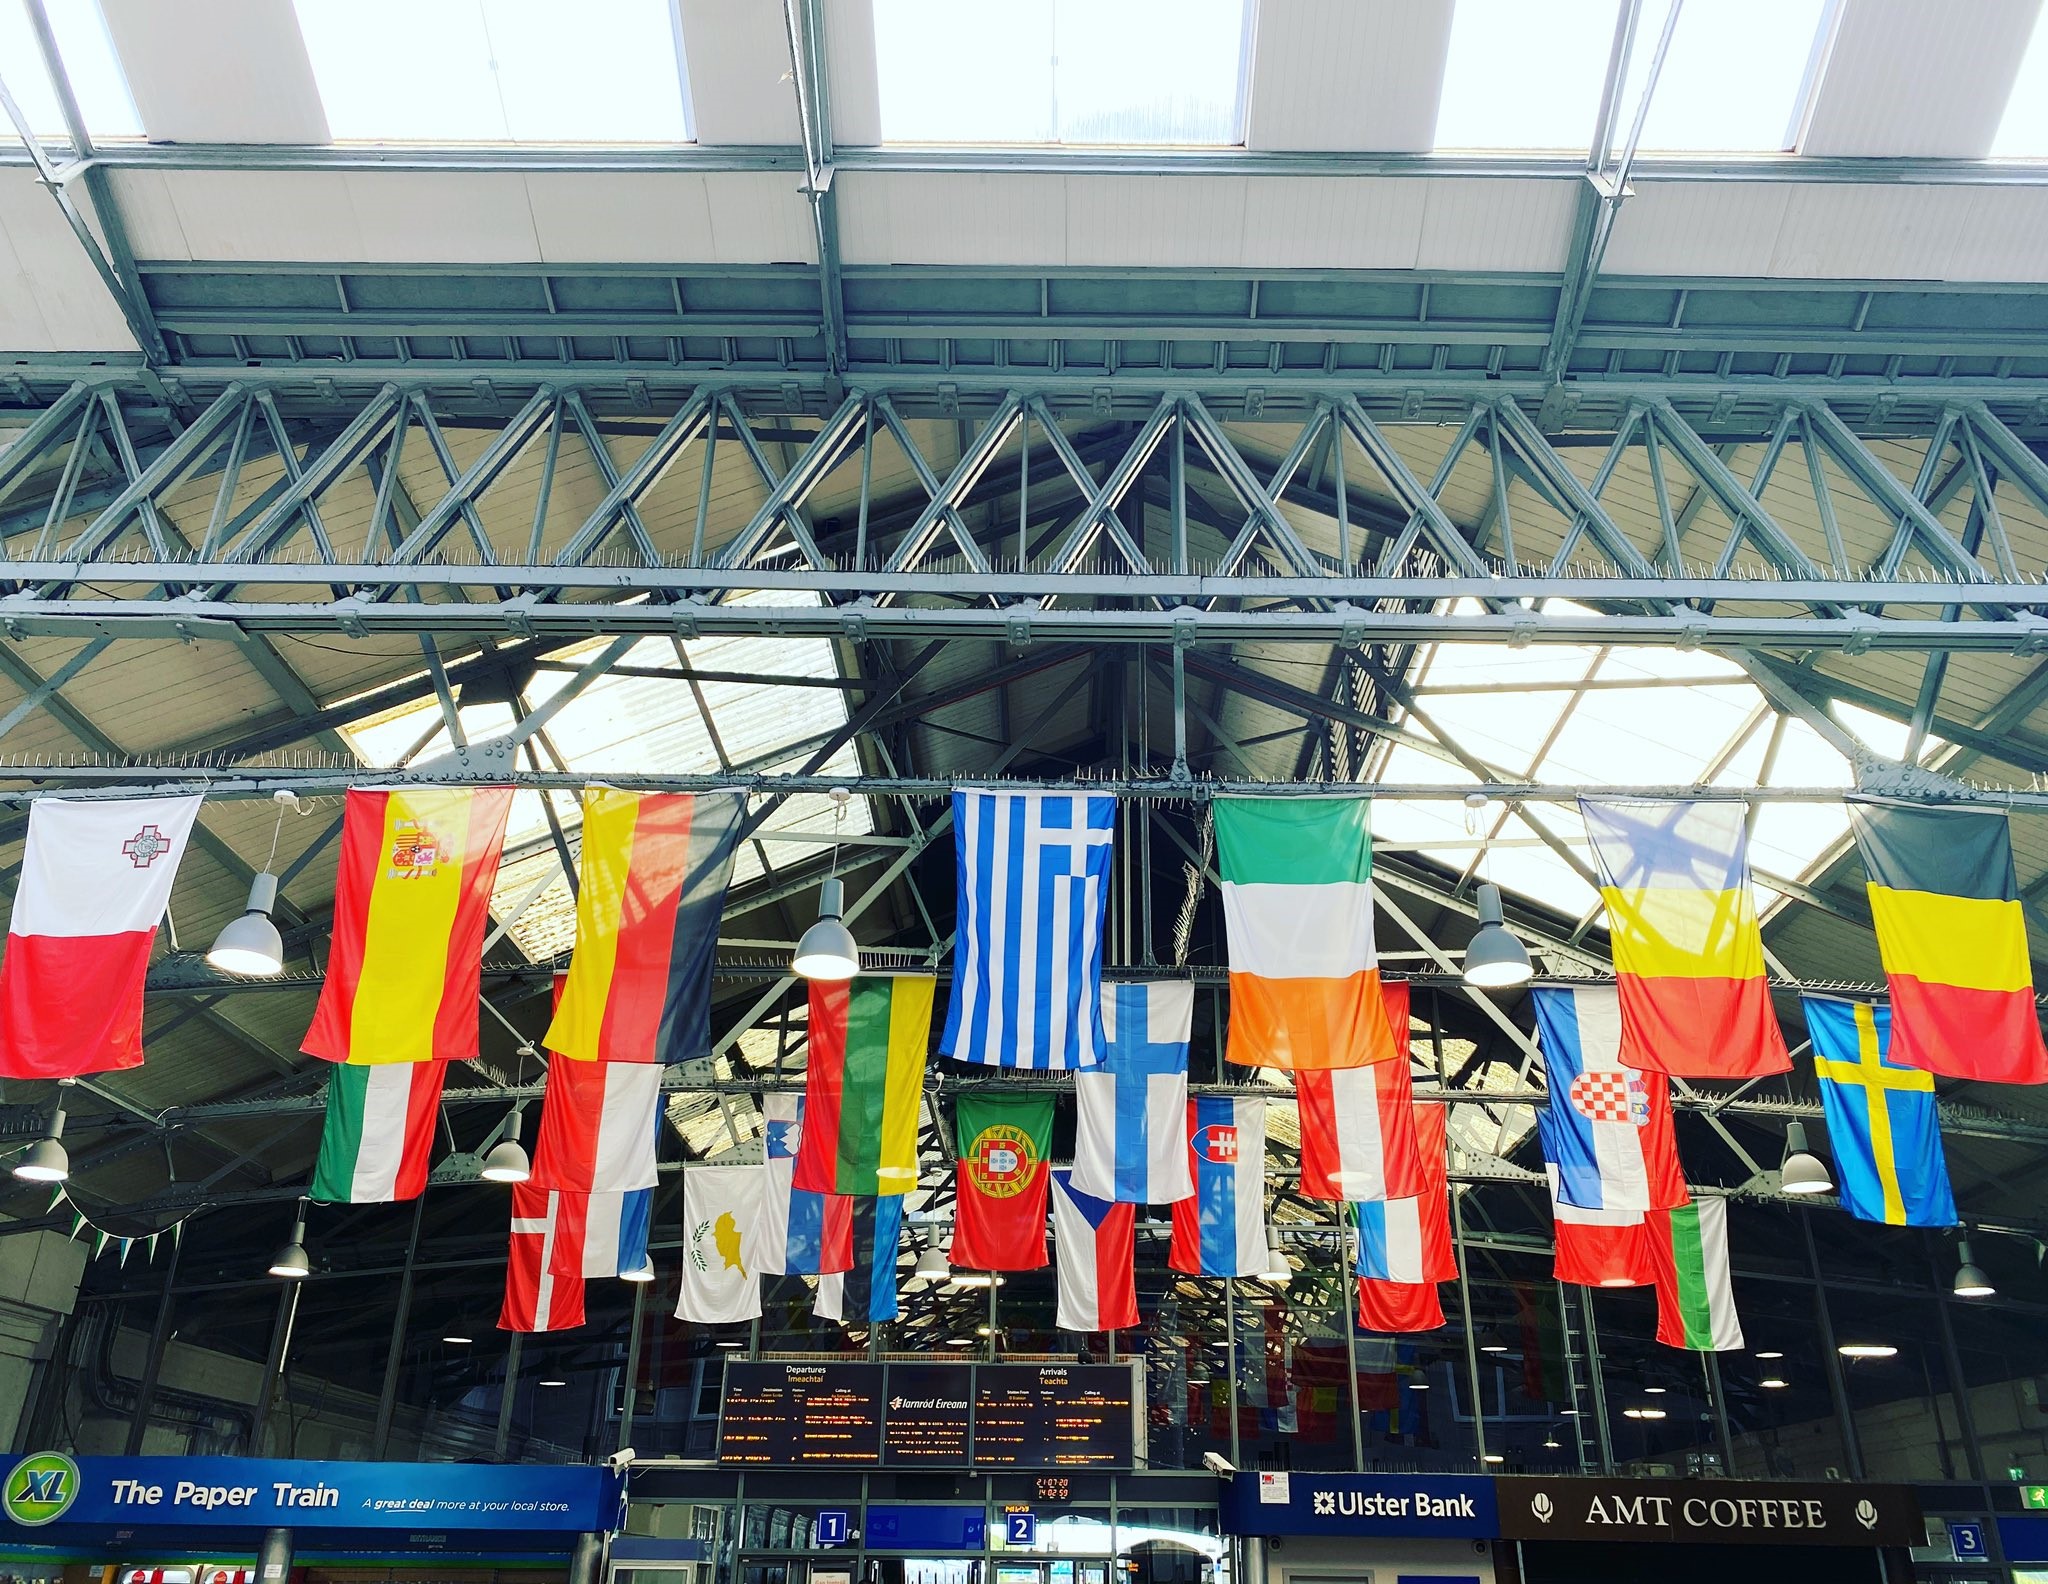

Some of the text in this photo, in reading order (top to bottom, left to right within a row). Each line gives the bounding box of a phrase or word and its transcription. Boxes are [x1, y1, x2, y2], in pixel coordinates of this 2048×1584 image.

[786, 1365, 826, 1374] Departures
[1039, 1368, 1068, 1376] Arrivals
[12, 1470, 68, 1503] XL
[111, 1480, 340, 1510] The Paper Train
[362, 1498, 570, 1512] A great deal more at your local store.
[1338, 1491, 1476, 1518] Ulster Bank
[1585, 1495, 1827, 1530] AMT COFFEE
[828, 1517, 837, 1537] 1
[1015, 1519, 1028, 1539] 2
[1961, 1530, 1976, 1549] 3
